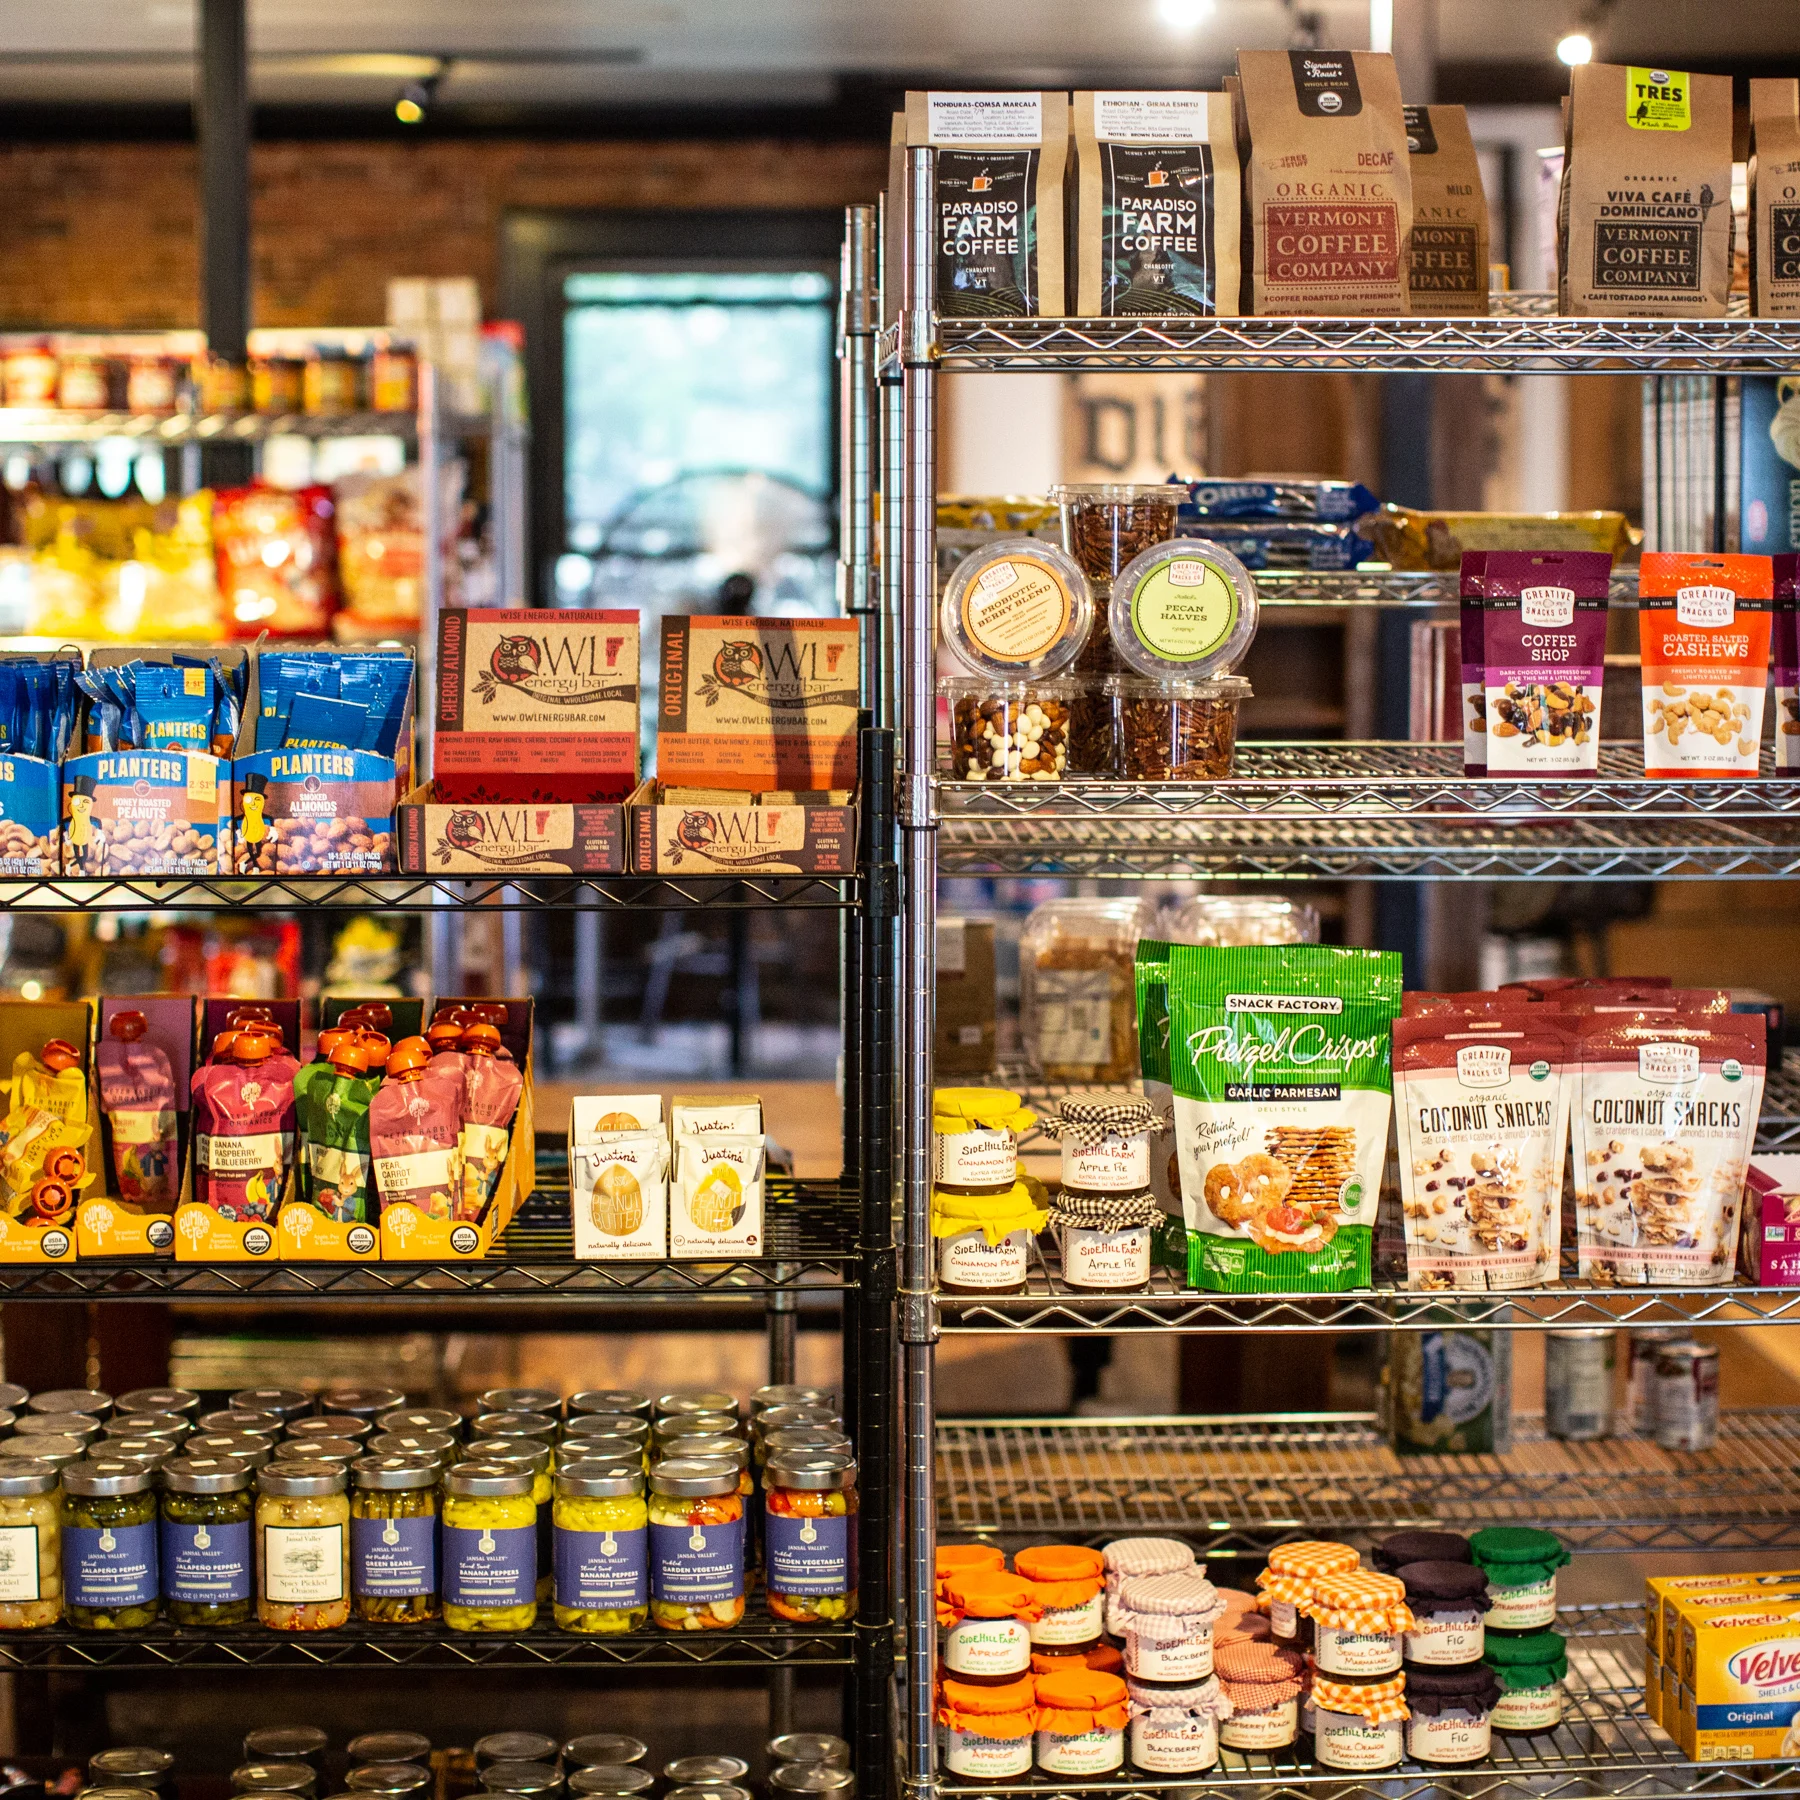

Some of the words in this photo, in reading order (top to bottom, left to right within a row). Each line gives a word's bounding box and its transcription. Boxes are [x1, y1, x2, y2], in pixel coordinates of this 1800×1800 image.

[1304, 60, 1342, 70] Signature
[1312, 69, 1336, 78] Roast
[1636, 84, 1682, 101] TRES
[1358, 153, 1393, 166] DECAF
[1276, 183, 1383, 197] ORGANIC
[1447, 185, 1472, 195] MILD
[1608, 191, 1644, 203] VIVA
[1652, 189, 1691, 203] CAFÉ
[942, 201, 1018, 216] PARADISO
[1121, 198, 1196, 212] PARADISO
[1601, 206, 1698, 218] DOMINICANO
[1122, 212, 1196, 235] FARM
[1276, 211, 1386, 226] VERMONT
[944, 216, 1017, 237] FARM
[1605, 229, 1691, 242] VERMONT
[943, 239, 1018, 255] COFFEE
[1121, 236, 1197, 252] COFFEE
[1276, 235, 1388, 255] COFFEE
[1603, 249, 1691, 265] COFFEE
[1277, 262, 1388, 278] COMPANY
[1603, 270, 1691, 284] COMPANY
[1588, 293, 1608, 301] CAFÉ
[1196, 486, 1267, 506] OREO
[980, 582, 1037, 615] PROBIOTIC
[1526, 591, 1571, 601] CREATIVE
[1681, 591, 1730, 601] CREATIVE
[977, 604, 1013, 628] BERRY
[1014, 583, 1051, 608] BLEND
[1166, 604, 1204, 612] PECAN
[500, 612, 521, 620] WISE
[1161, 613, 1207, 621] HALVES
[443, 615, 461, 670] ALMOND
[1522, 635, 1577, 647] COFFEE
[1531, 649, 1570, 661] SHOP
[1663, 643, 1748, 658] CASHEWS
[665, 630, 684, 716] ORIGINAL
[525, 677, 579, 693] energy
[582, 675, 608, 688] bar
[747, 681, 800, 697] energy
[804, 680, 829, 693] bar
[441, 673, 459, 721] CHERRY
[98, 758, 182, 781] PLANTERS
[271, 754, 354, 777] PLANTERS
[113, 798, 137, 807] HONEY
[139, 798, 171, 807] ROASTED
[290, 801, 337, 812] ALMONDS
[117, 807, 166, 819] PEANUTS
[640, 810, 651, 870] ORIGINAL
[1230, 998, 1273, 1008] SNACK
[1278, 999, 1337, 1010] FACTORY
[1187, 1025, 1290, 1079] Pretzel
[1289, 1025, 1376, 1074] Crisps
[1463, 1052, 1506, 1062] CREATIVE
[1228, 1086, 1271, 1098] GARLIC
[1274, 1087, 1337, 1098] PARMESAN
[1469, 1092, 1507, 1104] organic
[1420, 1104, 1488, 1133] COCONUT
[1497, 1101, 1552, 1126] SNACKS
[1594, 1100, 1664, 1124] COCONUT
[1675, 1102, 1740, 1127] SNACKS
[1196, 1118, 1237, 1139] Rethink
[215, 1141, 244, 1149] BANANA,
[1193, 1140, 1212, 1160] your
[1213, 1129, 1250, 1153] pretzel!
[215, 1149, 255, 1157] RASPBERRY
[593, 1150, 637, 1167] Justin's
[702, 1149, 744, 1164] Justin's
[1112, 1148, 1135, 1159] FARM
[221, 1157, 262, 1165] BLUEBERRY
[381, 1162, 402, 1170] PEAR,
[1079, 1162, 1111, 1172] APPLE
[1114, 1164, 1128, 1172] PIE
[382, 1169, 410, 1178] CARROT
[592, 1193, 639, 1211] PEANUT
[594, 1210, 641, 1230] BUTTER
[588, 1242, 619, 1250] naturally
[951, 1258, 998, 1267] CINNAMON
[1089, 1259, 1121, 1270] APPLE
[1124, 1260, 1136, 1268] PIE
[82, 1566, 117, 1574] JALAPEÑO
[120, 1564, 146, 1573] PEPPERS
[176, 1562, 211, 1571] JALAPEÑO
[691, 1564, 733, 1572] VEGETABLES
[580, 1571, 610, 1579] BANANA
[280, 1580, 299, 1588] Spicy
[301, 1579, 328, 1587] Pickled
[1711, 1615, 1784, 1628] Velveeta
[1447, 1635, 1464, 1646] FIG
[968, 1647, 1012, 1657] APRICOT
[1727, 1711, 1773, 1723] Original
[1452, 1732, 1469, 1743] FIG
[1059, 1747, 1103, 1756] APRICOT
[1147, 1744, 1200, 1754] BLACKBERRY
[1332, 1750, 1378, 1759] MARMALADE
